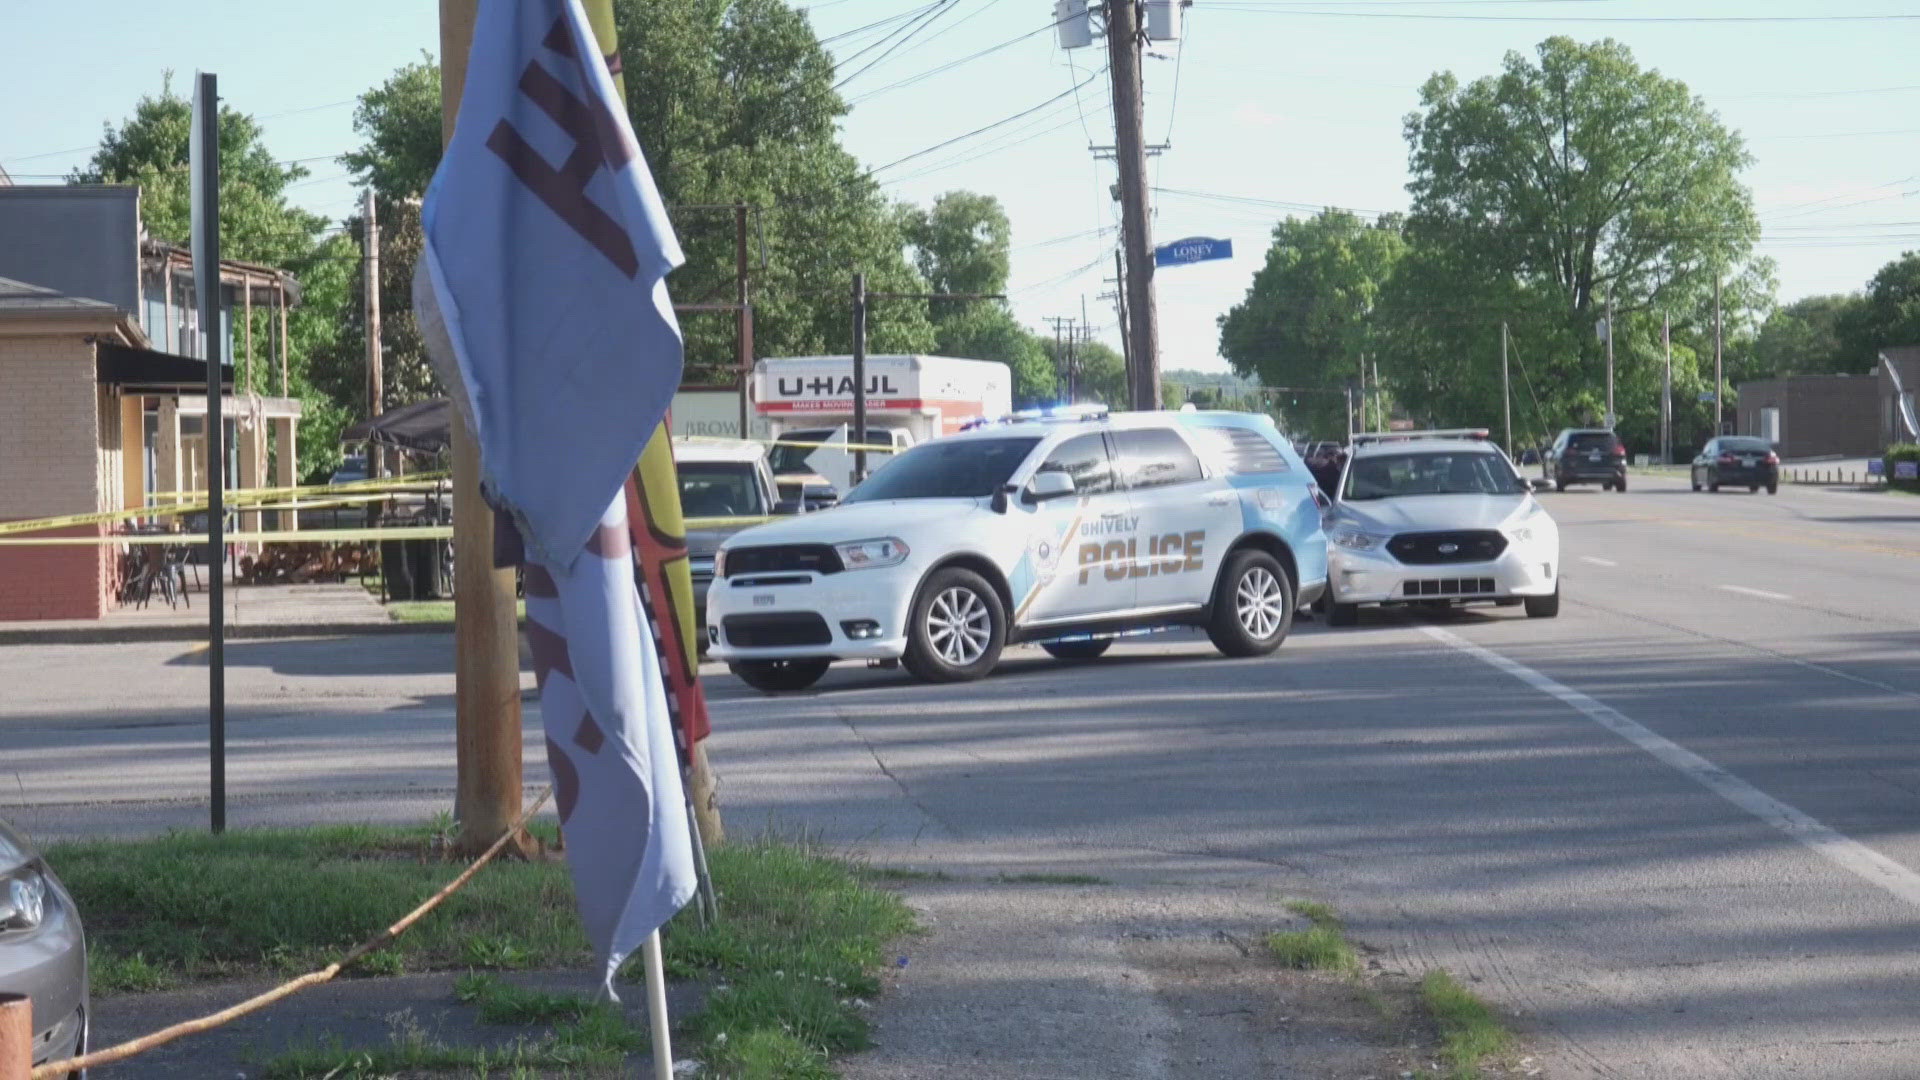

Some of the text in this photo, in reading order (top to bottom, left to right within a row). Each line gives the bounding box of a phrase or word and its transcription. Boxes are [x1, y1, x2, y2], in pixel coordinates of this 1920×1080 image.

[1173, 243, 1213, 257] LONEY
[792, 401, 821, 409] MAKES
[1081, 516, 1139, 536] SHIVELY
[1079, 530, 1205, 586] POLICE
